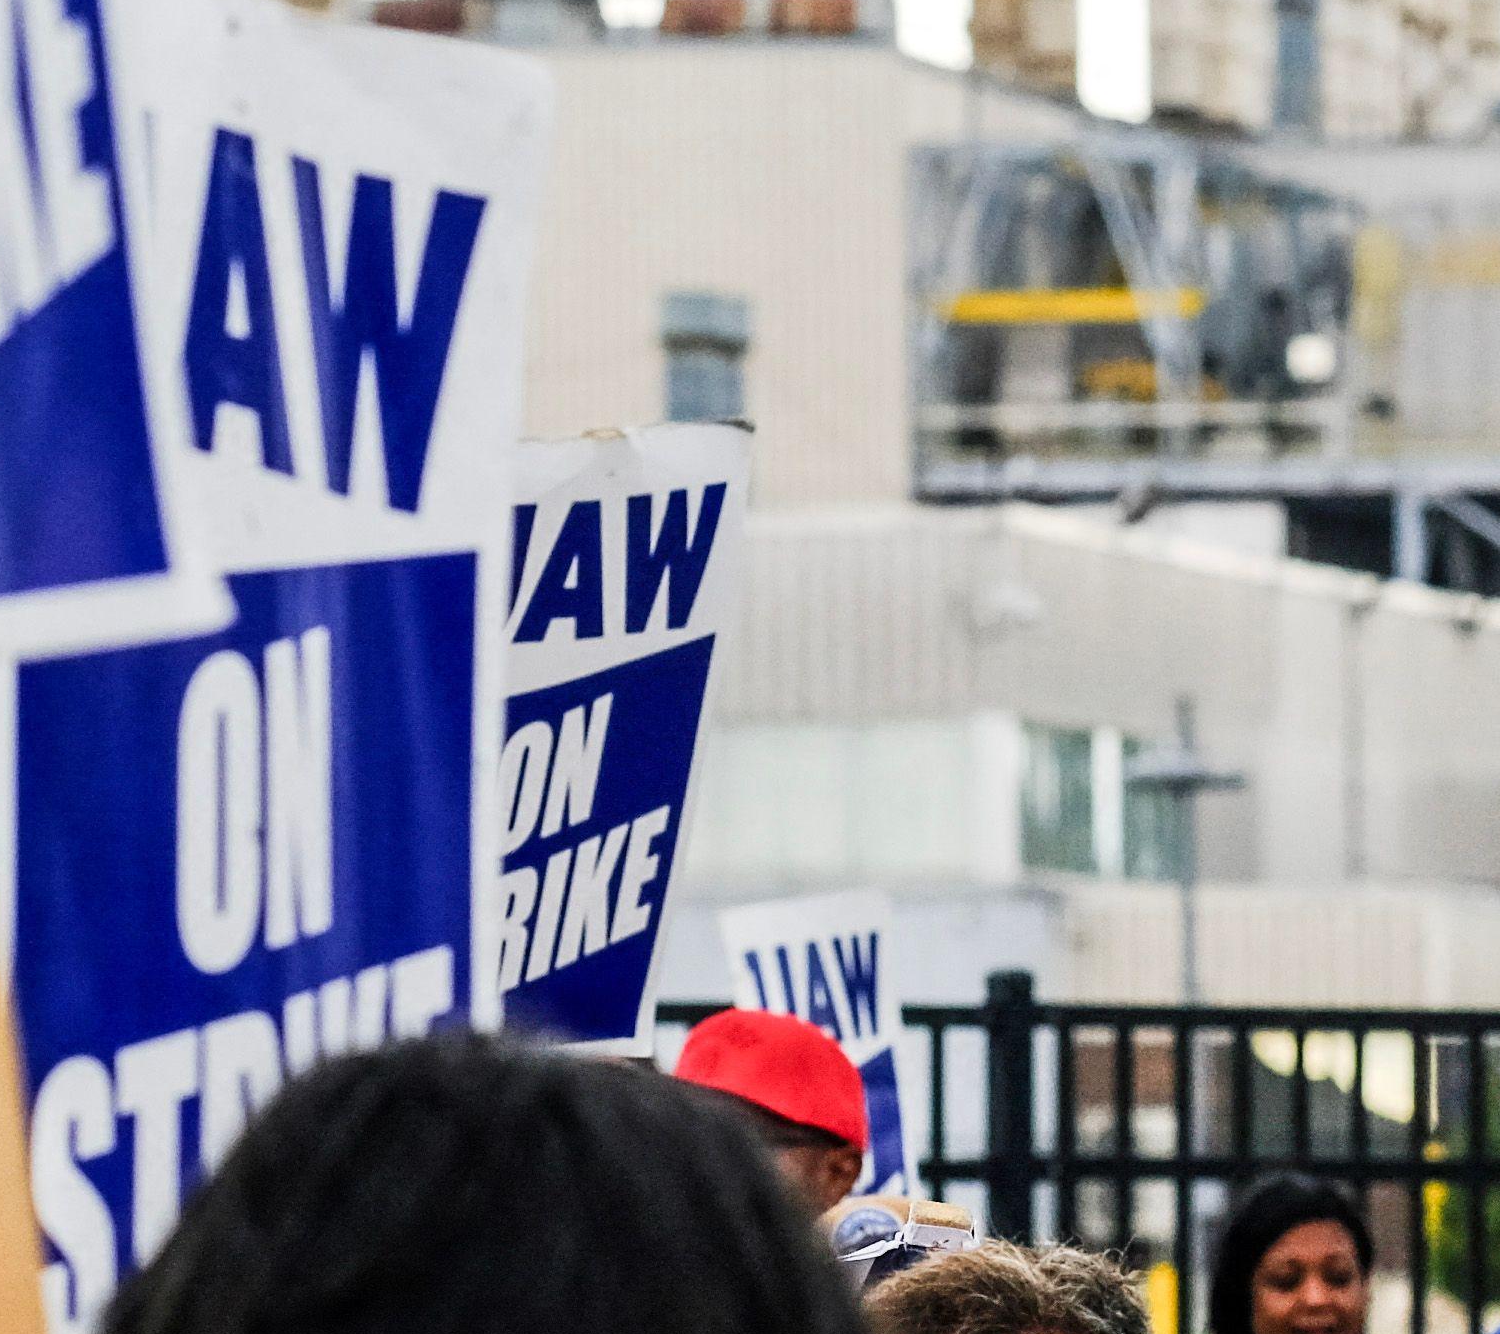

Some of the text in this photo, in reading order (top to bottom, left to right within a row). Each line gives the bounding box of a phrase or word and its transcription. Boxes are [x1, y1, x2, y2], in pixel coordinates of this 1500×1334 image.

[183, 125, 489, 515] AW
[176, 626, 332, 975] ON
[498, 691, 613, 859] ON
